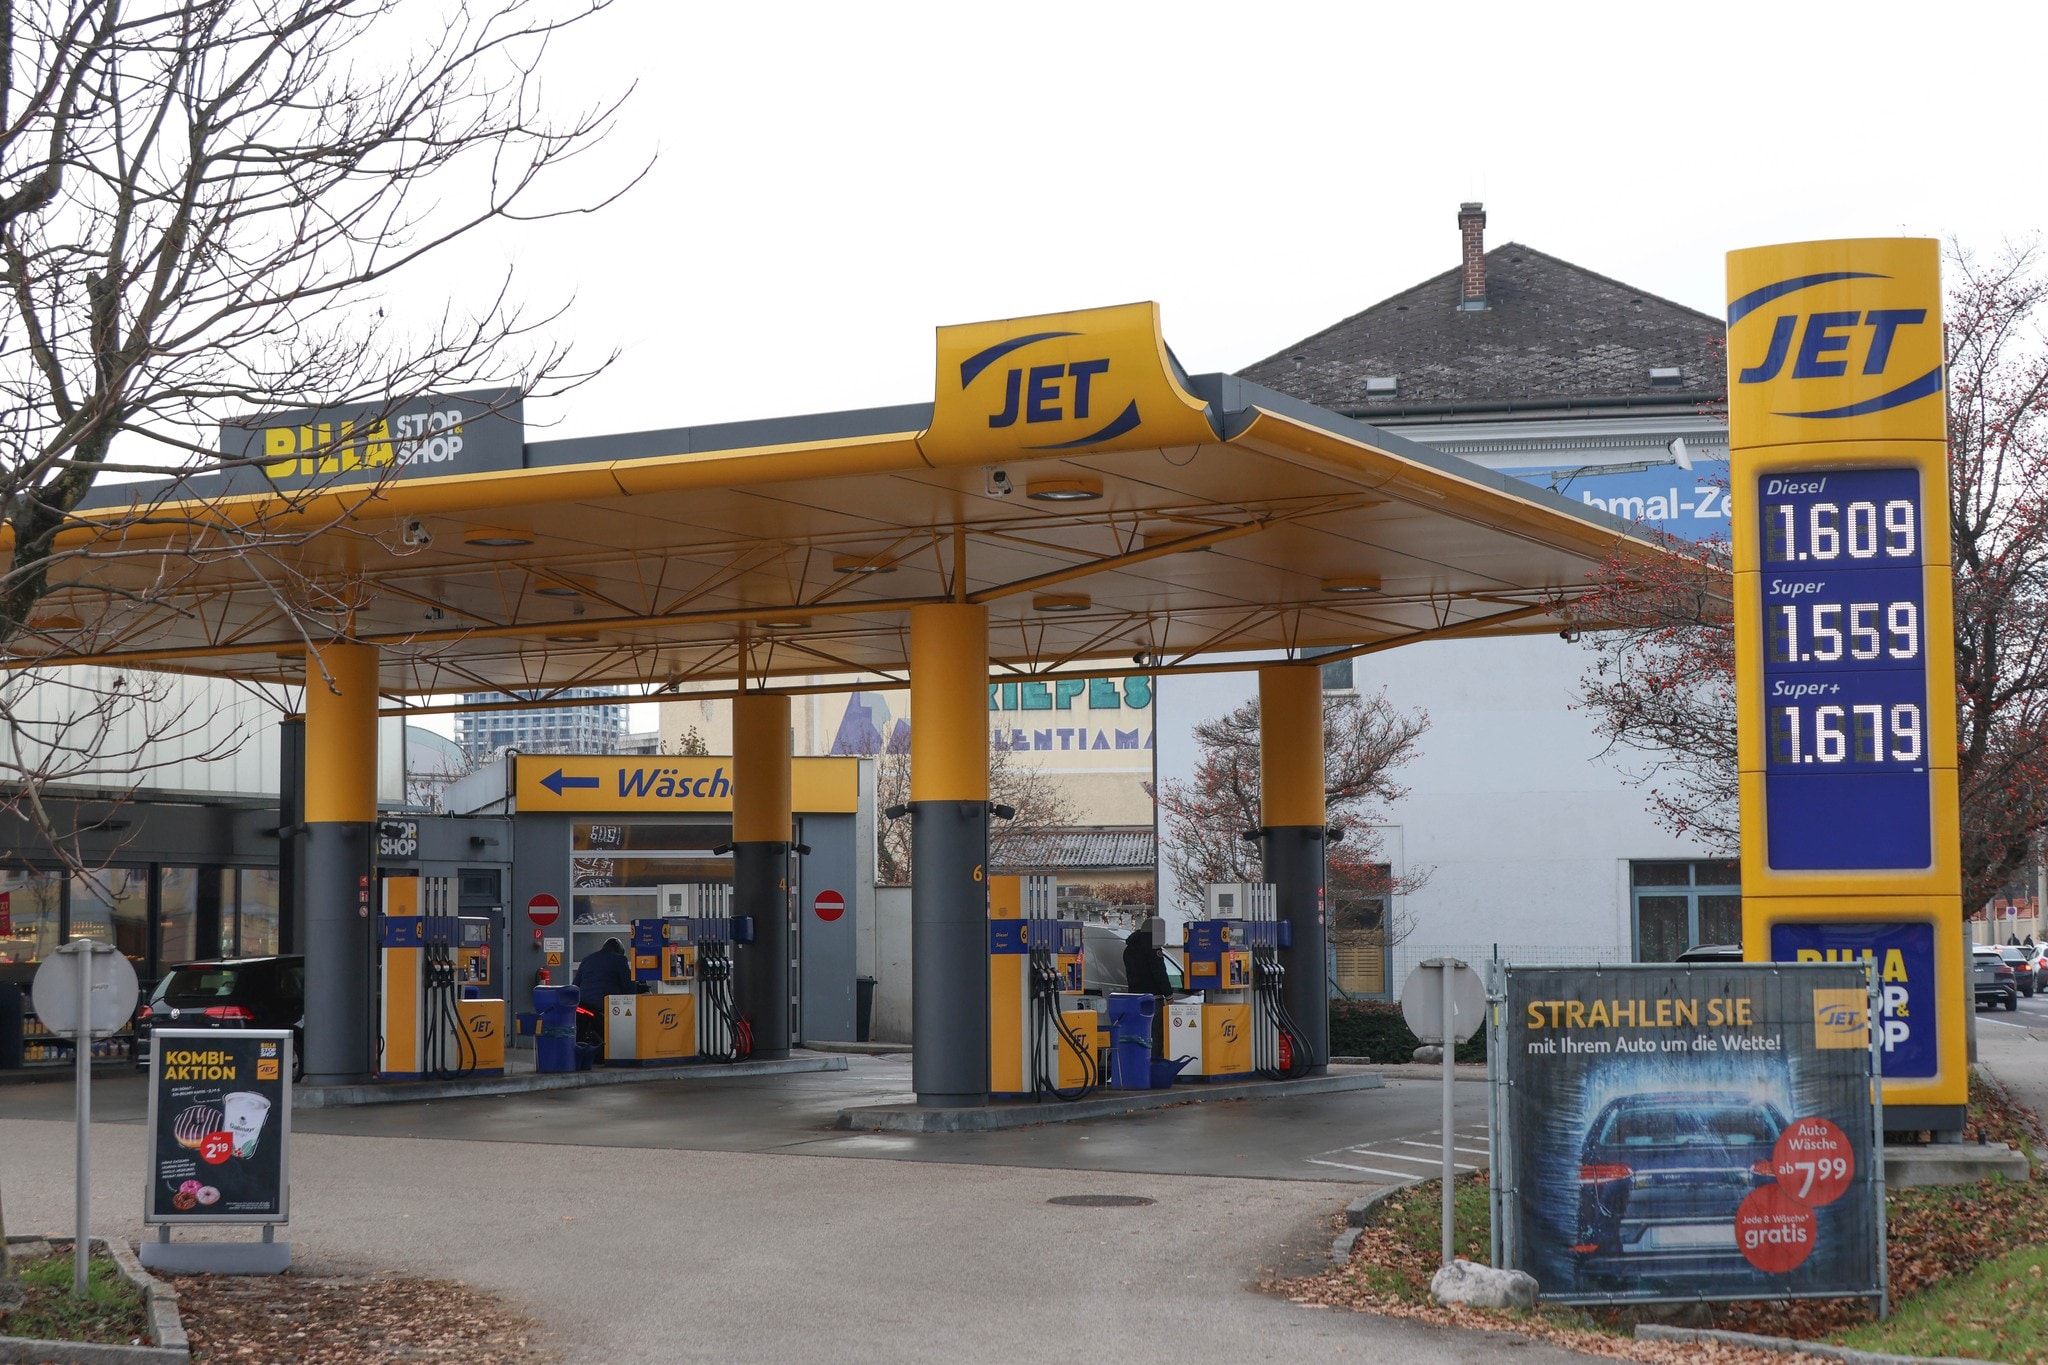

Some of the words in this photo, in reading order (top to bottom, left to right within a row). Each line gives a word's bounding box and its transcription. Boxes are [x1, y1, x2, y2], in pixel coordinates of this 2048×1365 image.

[1738, 308, 1927, 384] JET
[988, 358, 1110, 428] JET
[396, 409, 463, 438] STOP
[264, 417, 396, 479] BILLA
[396, 435, 464, 466] SHOP
[1766, 477, 1827, 496] Diesel
[1780, 499, 1915, 561] 1.609
[1769, 579, 1825, 598] Super
[1783, 601, 1918, 662] 1.559
[1772, 680, 1841, 699] Super+
[1786, 703, 1922, 764] 1.679
[618, 766, 733, 798] Wäsch
[380, 838, 417, 856] SHOP
[972, 863, 983, 882] 6
[778, 878, 787, 891] 4
[659, 1013, 676, 1025] JET
[1527, 998, 1698, 1030] STRAHLEN
[1707, 998, 1753, 1027] SIE
[1824, 1011, 1860, 1026] JET
[472, 1020, 491, 1033] JET
[1222, 1023, 1236, 1037] JET
[1528, 1037, 1556, 1055] mit
[1561, 1036, 1612, 1054] Ihrem
[1615, 1035, 1657, 1053] Auto
[1660, 1038, 1688, 1053] um
[1691, 1034, 1718, 1051] die
[1721, 1033, 1782, 1051] Wette!
[165, 1050, 234, 1066] KOMBI-
[164, 1066, 236, 1080] AKTION
[1797, 1124, 1828, 1136] Auto
[206, 1143, 229, 1159] 219
[1788, 1138, 1838, 1151] Wäsche
[1778, 1161, 1795, 1175] ab
[1794, 1157, 1847, 1199] 799
[1741, 1215, 1763, 1225] Jede
[1764, 1215, 1772, 1224] 8.
[1744, 1224, 1808, 1249] gratis
